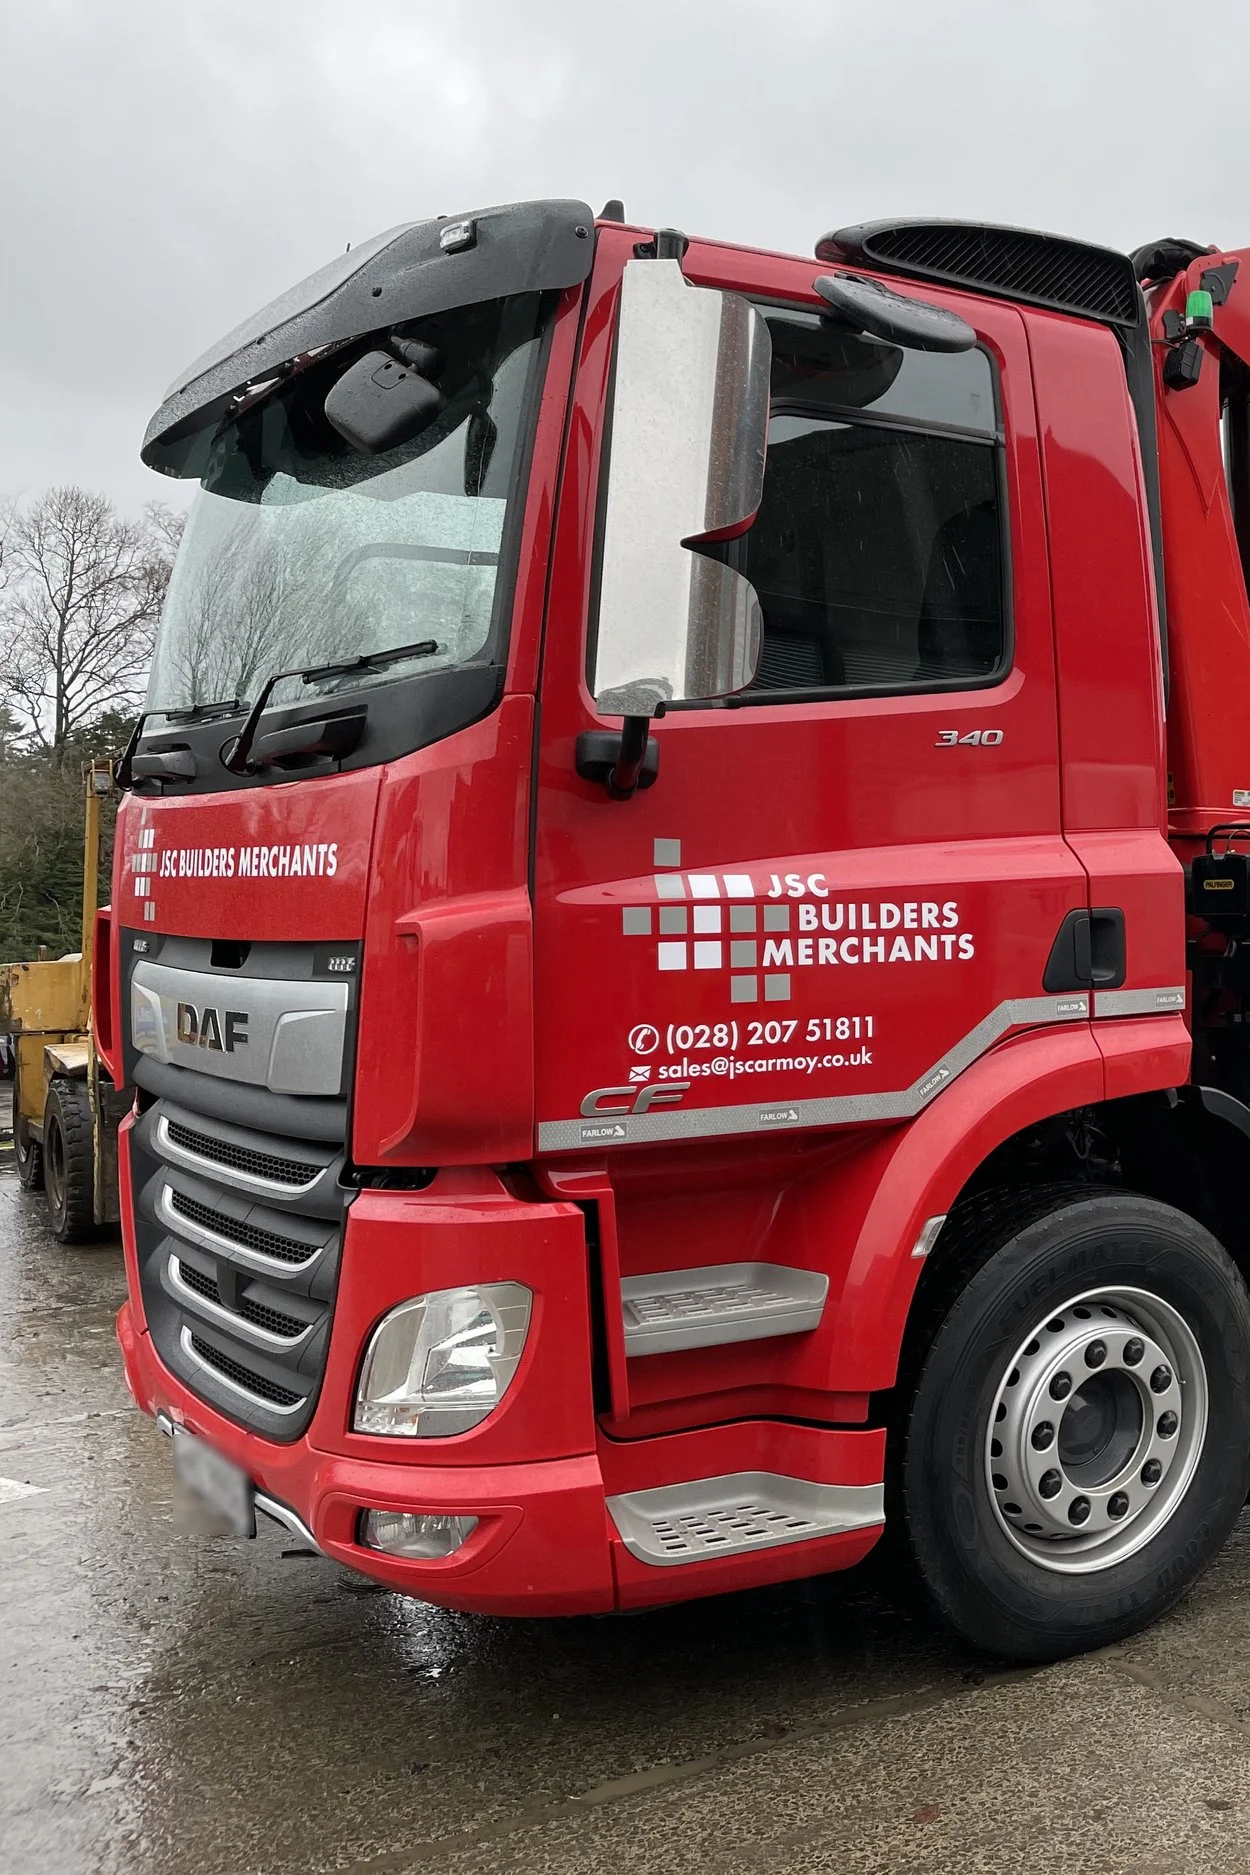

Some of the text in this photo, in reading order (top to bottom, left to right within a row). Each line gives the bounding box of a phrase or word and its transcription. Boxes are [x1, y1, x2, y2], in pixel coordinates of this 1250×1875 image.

[934, 729, 1004, 747] 340
[159, 843, 338, 878] JSC BUILDERS MERCHANTS
[767, 873, 829, 898] JSC
[798, 902, 959, 932] BUILDERS
[762, 933, 975, 967] MERCHANTS
[177, 1002, 249, 1053] DAF
[666, 1015, 873, 1055] (028) 207 51811
[658, 1046, 873, 1080] sales@jscarmoy.co.uk
[580, 1081, 691, 1117] CF
[760, 1111, 788, 1121] FARLOW
[582, 1127, 614, 1138] FARLOW
